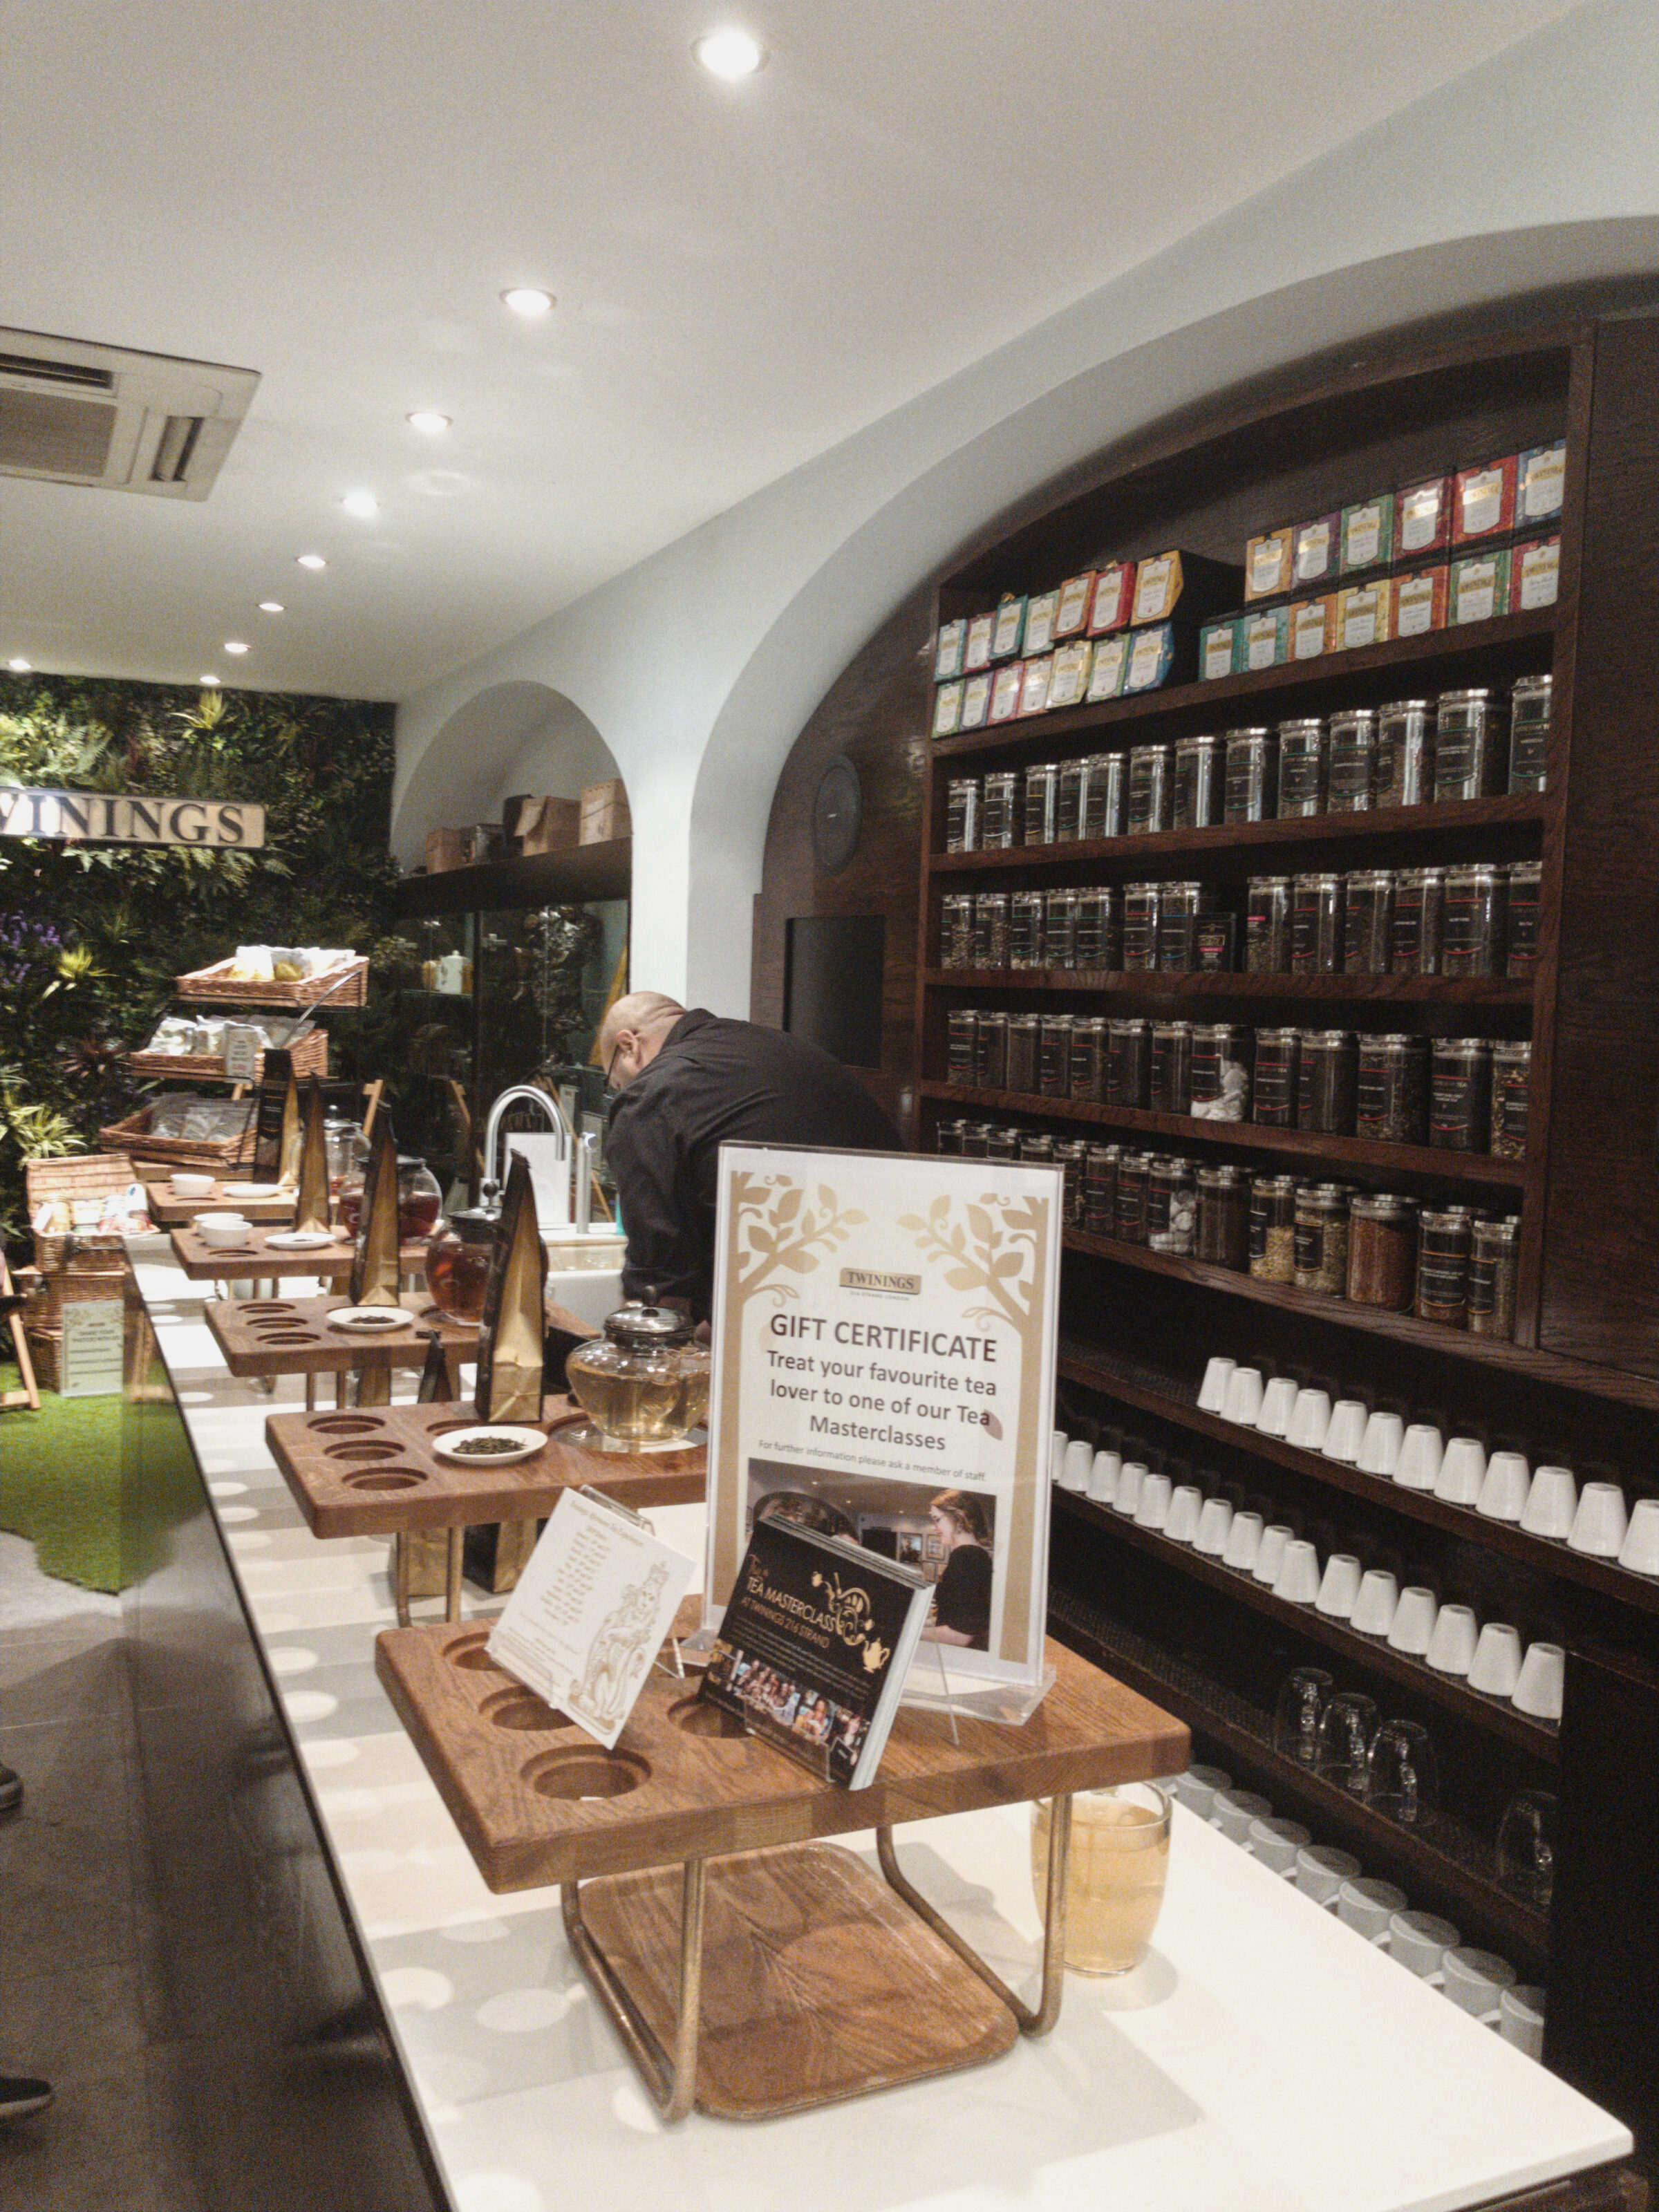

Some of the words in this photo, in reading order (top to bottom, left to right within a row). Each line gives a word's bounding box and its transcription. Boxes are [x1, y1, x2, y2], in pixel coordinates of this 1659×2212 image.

[848, 1271, 915, 1289] TWININGS
[770, 1313, 827, 1340] GIFT
[834, 1321, 997, 1363] CERTIFICATE
[767, 1350, 815, 1372] Treat
[820, 1359, 864, 1381] your
[870, 1362, 959, 1391] favourite
[965, 1376, 997, 1396] tea
[770, 1379, 818, 1403] lover
[823, 1387, 843, 1405] to
[849, 1396, 885, 1412] one
[891, 1396, 912, 1415] of
[917, 1404, 951, 1421] our
[957, 1405, 991, 1426] Tea
[809, 1415, 946, 1450] Masterclasses
[758, 1440, 772, 1450] For
[774, 1442, 804, 1455] further
[806, 1447, 856, 1462] information
[859, 1456, 886, 1468] please
[888, 1460, 903, 1470] ask
[912, 1463, 950, 1477] member
[953, 1469, 964, 1478] of
[746, 1577, 764, 1597] TEA
[765, 1586, 836, 1632] MASTERCLASS
[749, 1599, 785, 1627] TWININGS
[785, 1618, 799, 1633] 216
[798, 1624, 830, 1649] STRAND
